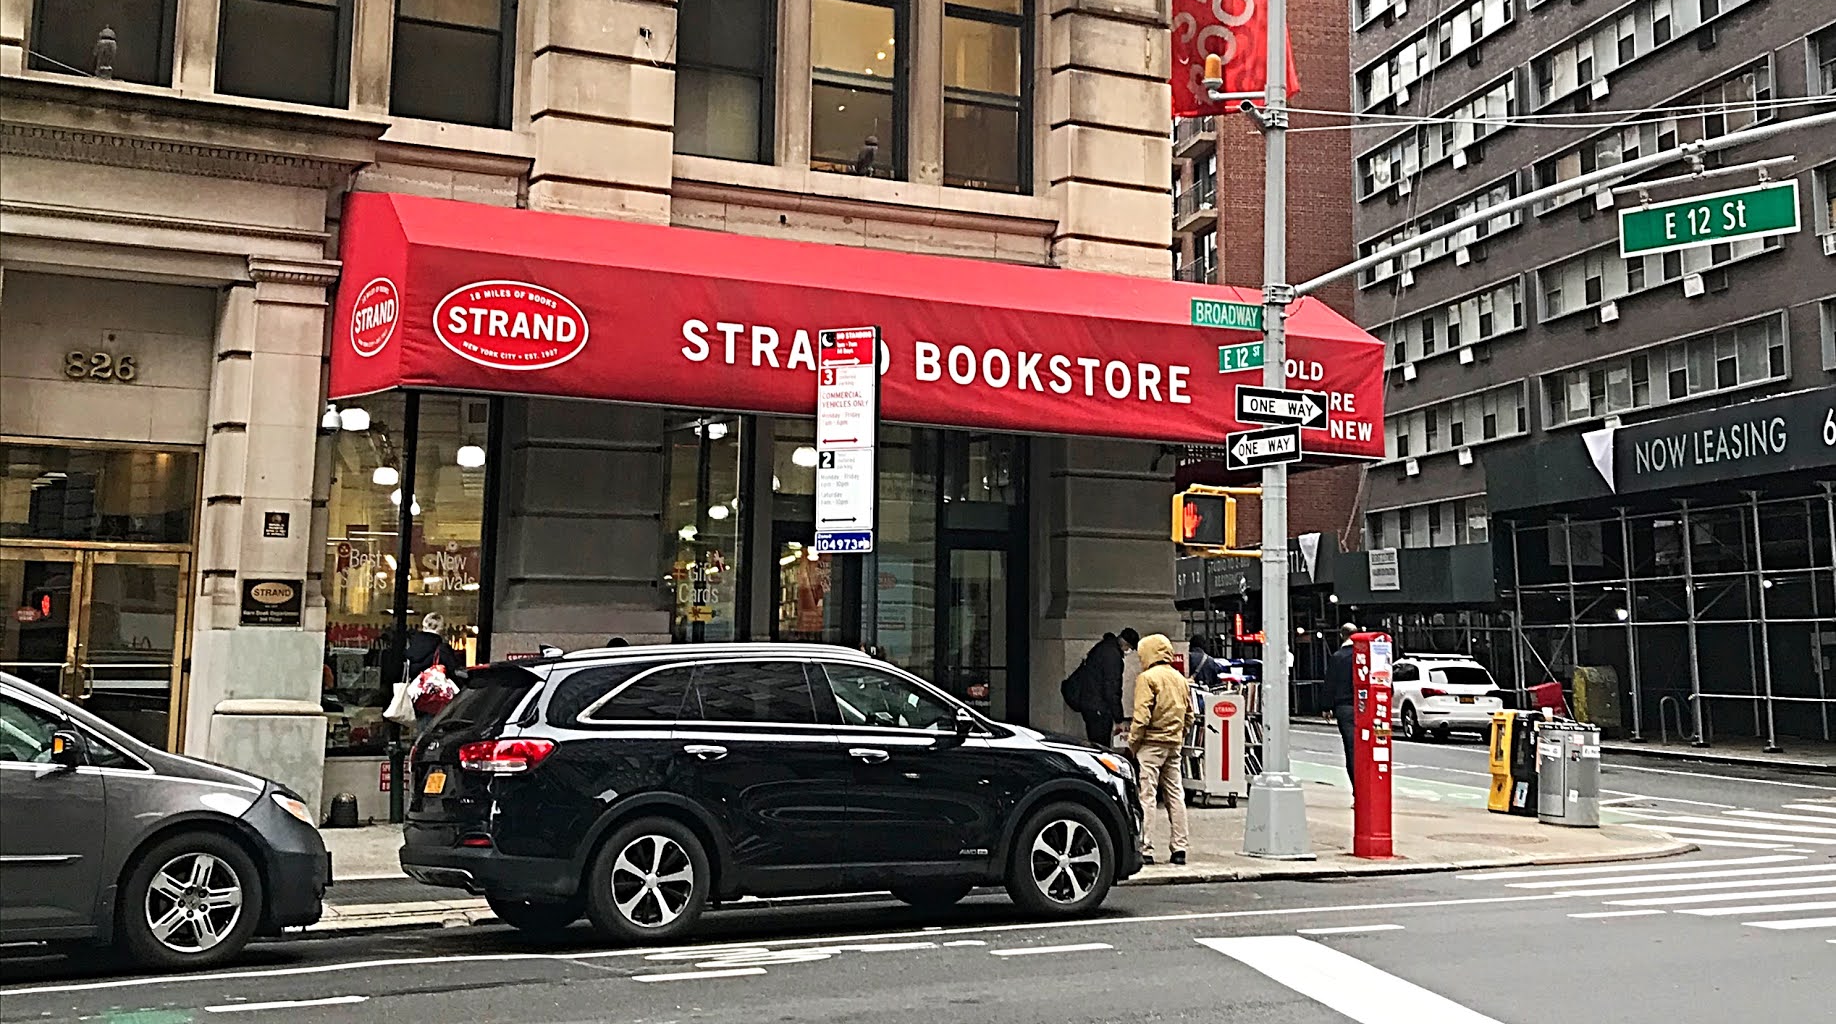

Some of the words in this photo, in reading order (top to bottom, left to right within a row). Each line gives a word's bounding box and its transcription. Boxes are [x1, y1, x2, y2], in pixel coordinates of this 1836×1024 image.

[1665, 212, 1677, 240] E
[1687, 206, 1711, 236] 12
[1722, 199, 1747, 231] St
[483, 289, 511, 299] MILES
[513, 289, 526, 299] OF
[528, 292, 558, 310] BOOKS
[354, 298, 395, 335] STRAND
[447, 305, 577, 343] STRAND
[1195, 301, 1259, 327] BROADWAY
[462, 340, 479, 352] NEW
[480, 347, 498, 359] YORK
[500, 351, 516, 360] CITY
[1223, 349, 1232, 370] E
[1236, 347, 1249, 368] 12
[1252, 345, 1261, 358] ST
[64, 350, 137, 381] 826
[681, 318, 891, 376] STRA
[915, 340, 1192, 404] BOOKSTORE
[1284, 358, 1324, 381] OLD
[823, 368, 834, 385] 3
[822, 391, 862, 399] COMMERCIAL
[822, 399, 852, 408] VEHICLES
[853, 399, 869, 408] ONLY
[1250, 398, 1276, 414] ONE
[1287, 402, 1314, 418] WAY
[1330, 419, 1373, 442] NEW
[1238, 441, 1259, 456] ONE
[1267, 437, 1291, 453] WAY
[1635, 433, 1687, 474] NOW
[1693, 417, 1787, 465] LEASING
[822, 451, 832, 468] 2
[817, 539, 858, 551] 104973
[349, 548, 382, 568] Best
[436, 551, 467, 570] New
[253, 588, 292, 597] STRAND
[678, 582, 719, 603] Cards
